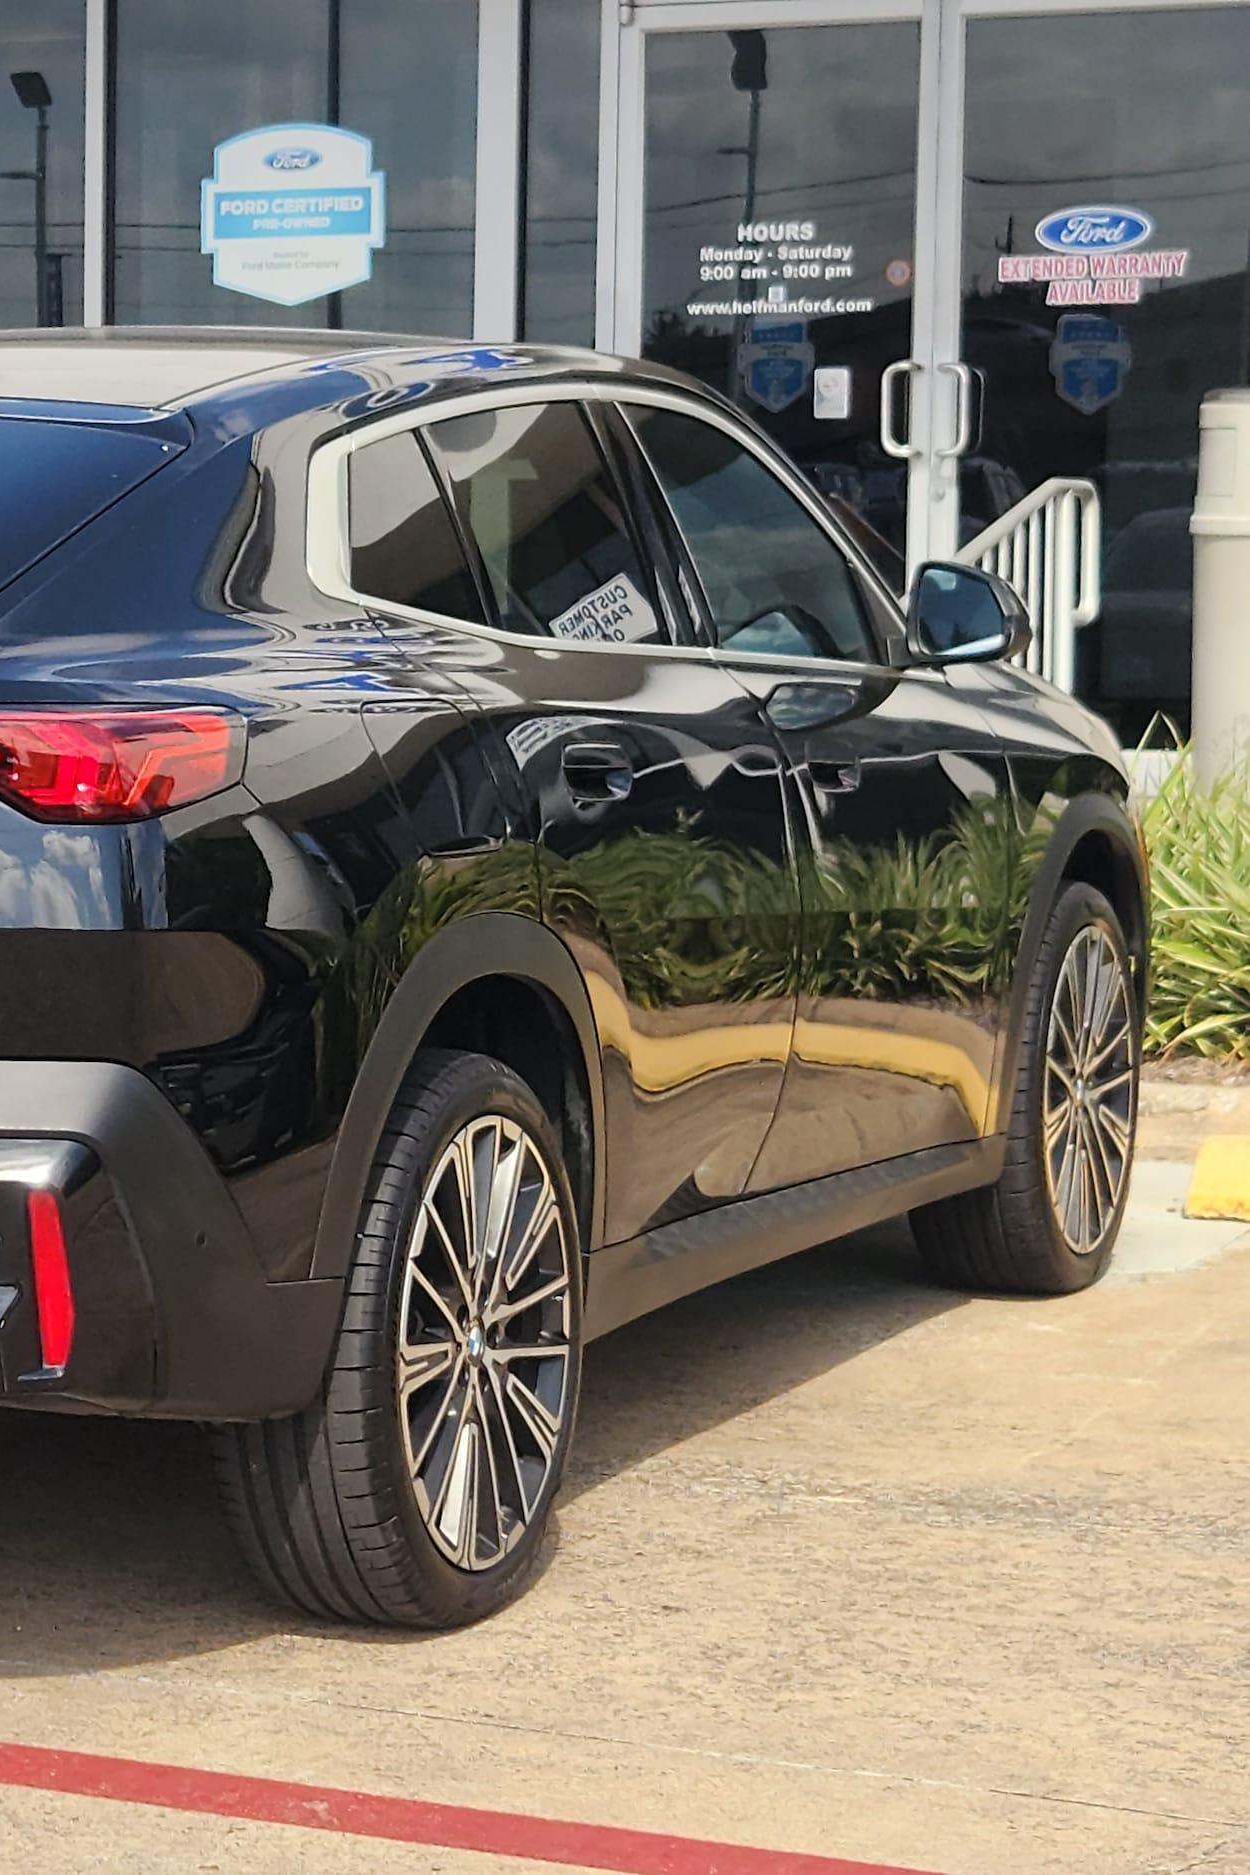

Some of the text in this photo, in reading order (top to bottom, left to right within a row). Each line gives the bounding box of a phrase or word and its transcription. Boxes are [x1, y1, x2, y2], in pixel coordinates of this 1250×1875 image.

[272, 152, 312, 169] Ford
[219, 195, 364, 216] FORD CERTIFIED
[252, 217, 331, 230] PRE-OWNED
[737, 222, 815, 243] HOURS
[1060, 216, 1126, 244] Ford
[700, 247, 763, 263] Monday
[777, 245, 852, 261] Saturday
[700, 265, 734, 281] 9:00
[740, 267, 767, 279] am
[782, 264, 820, 279] 9:00
[824, 266, 852, 281] pm
[1000, 253, 1187, 279] EXTENDED WARRANTY
[1049, 281, 1137, 301] AVAILABLE
[687, 299, 872, 316] www.helfmanford.com
